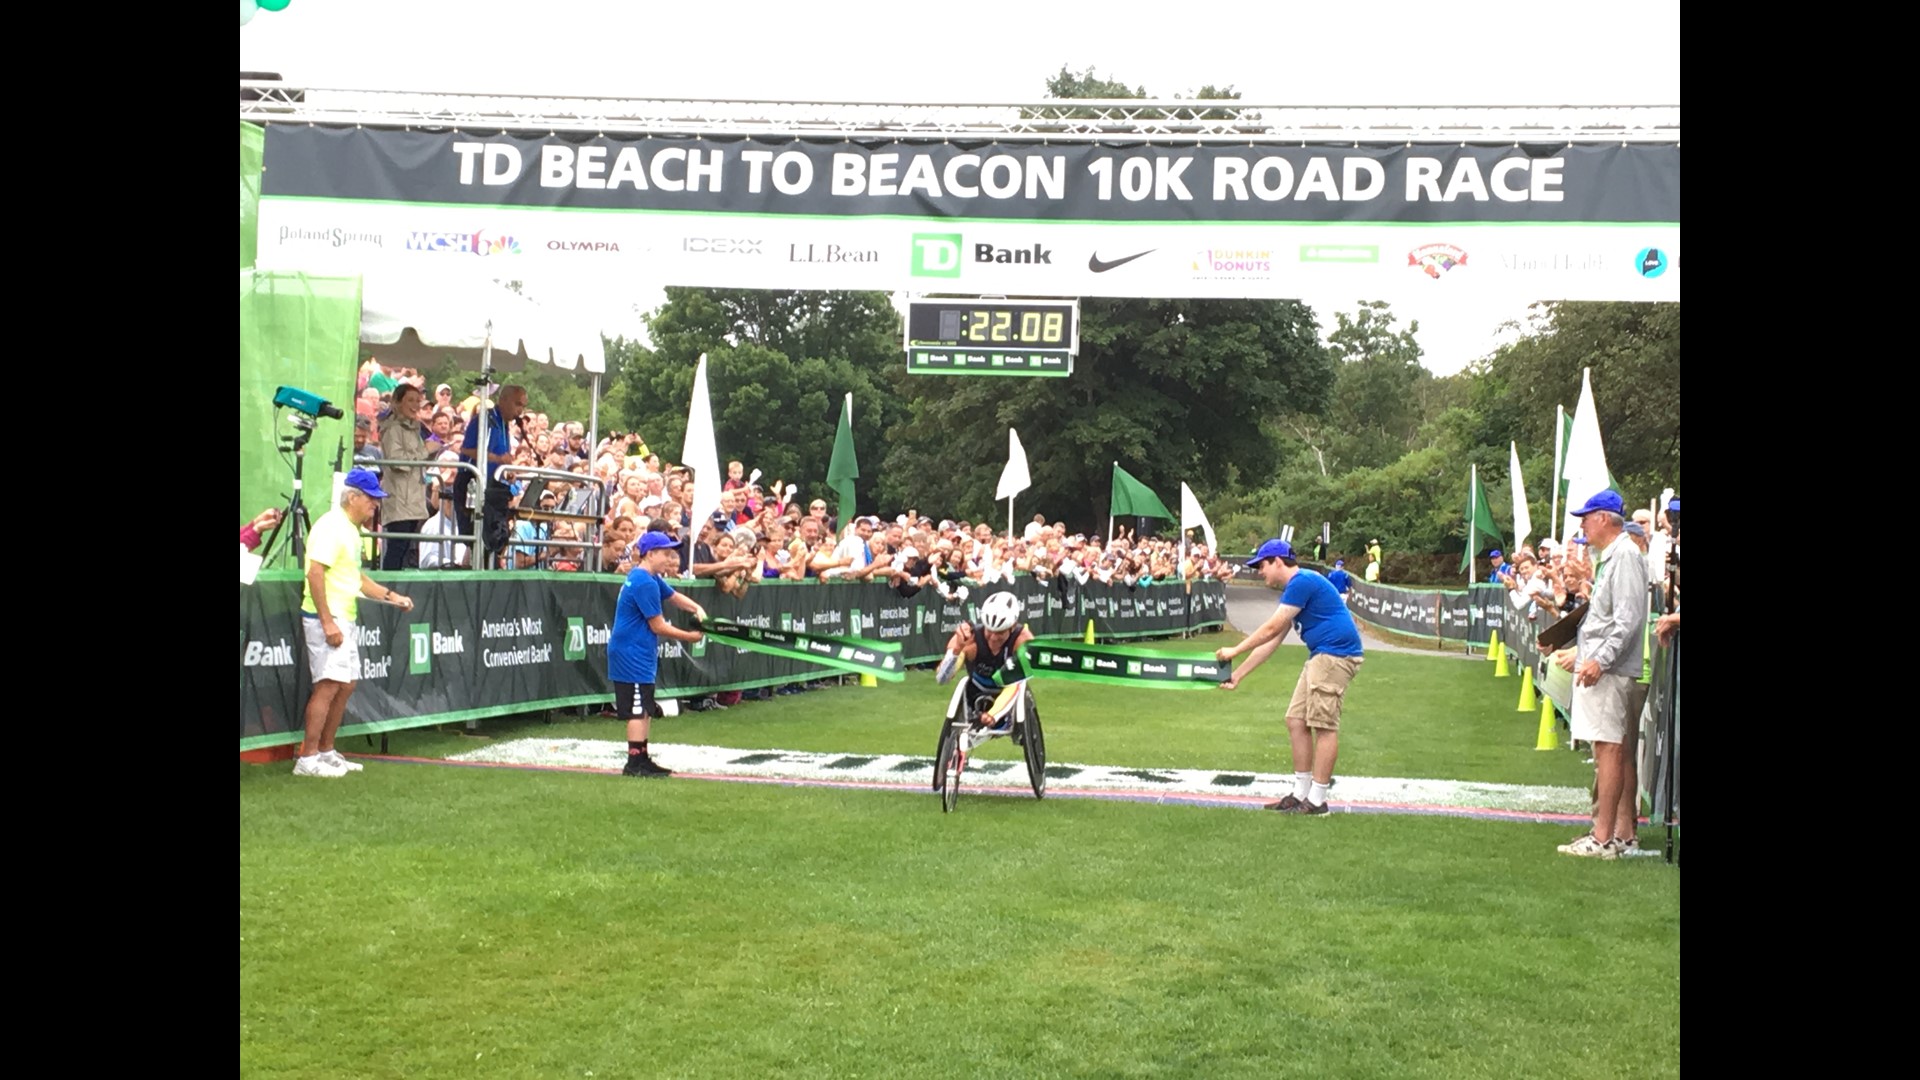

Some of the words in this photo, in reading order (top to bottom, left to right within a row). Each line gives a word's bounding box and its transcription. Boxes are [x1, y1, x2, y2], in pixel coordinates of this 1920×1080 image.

[452, 141, 523, 187] TD
[540, 144, 723, 192] BEACH
[742, 149, 814, 196] TO
[831, 152, 1066, 200] BEACON
[1087, 156, 1194, 201] 10K
[1212, 156, 1386, 201] ROAD
[1405, 156, 1565, 202] RACE
[546, 240, 620, 252] OLYMPIA
[683, 237, 763, 254] IDEXX
[789, 243, 879, 263] L.L.Bean
[915, 239, 959, 270] TD
[975, 243, 1052, 264] Bank
[1214, 261, 1270, 271] DONUTS
[355, 625, 381, 646] Most
[482, 617, 520, 638] America's
[521, 617, 543, 636] Most
[244, 638, 294, 666] Bank
[411, 632, 429, 664] TD
[433, 629, 464, 654] Bank
[483, 645, 530, 668] Convenient
[1053, 654, 1073, 664] Bank
[1096, 659, 1117, 669] Bank
[1143, 664, 1167, 673] Bank
[1194, 665, 1217, 675] Bank
